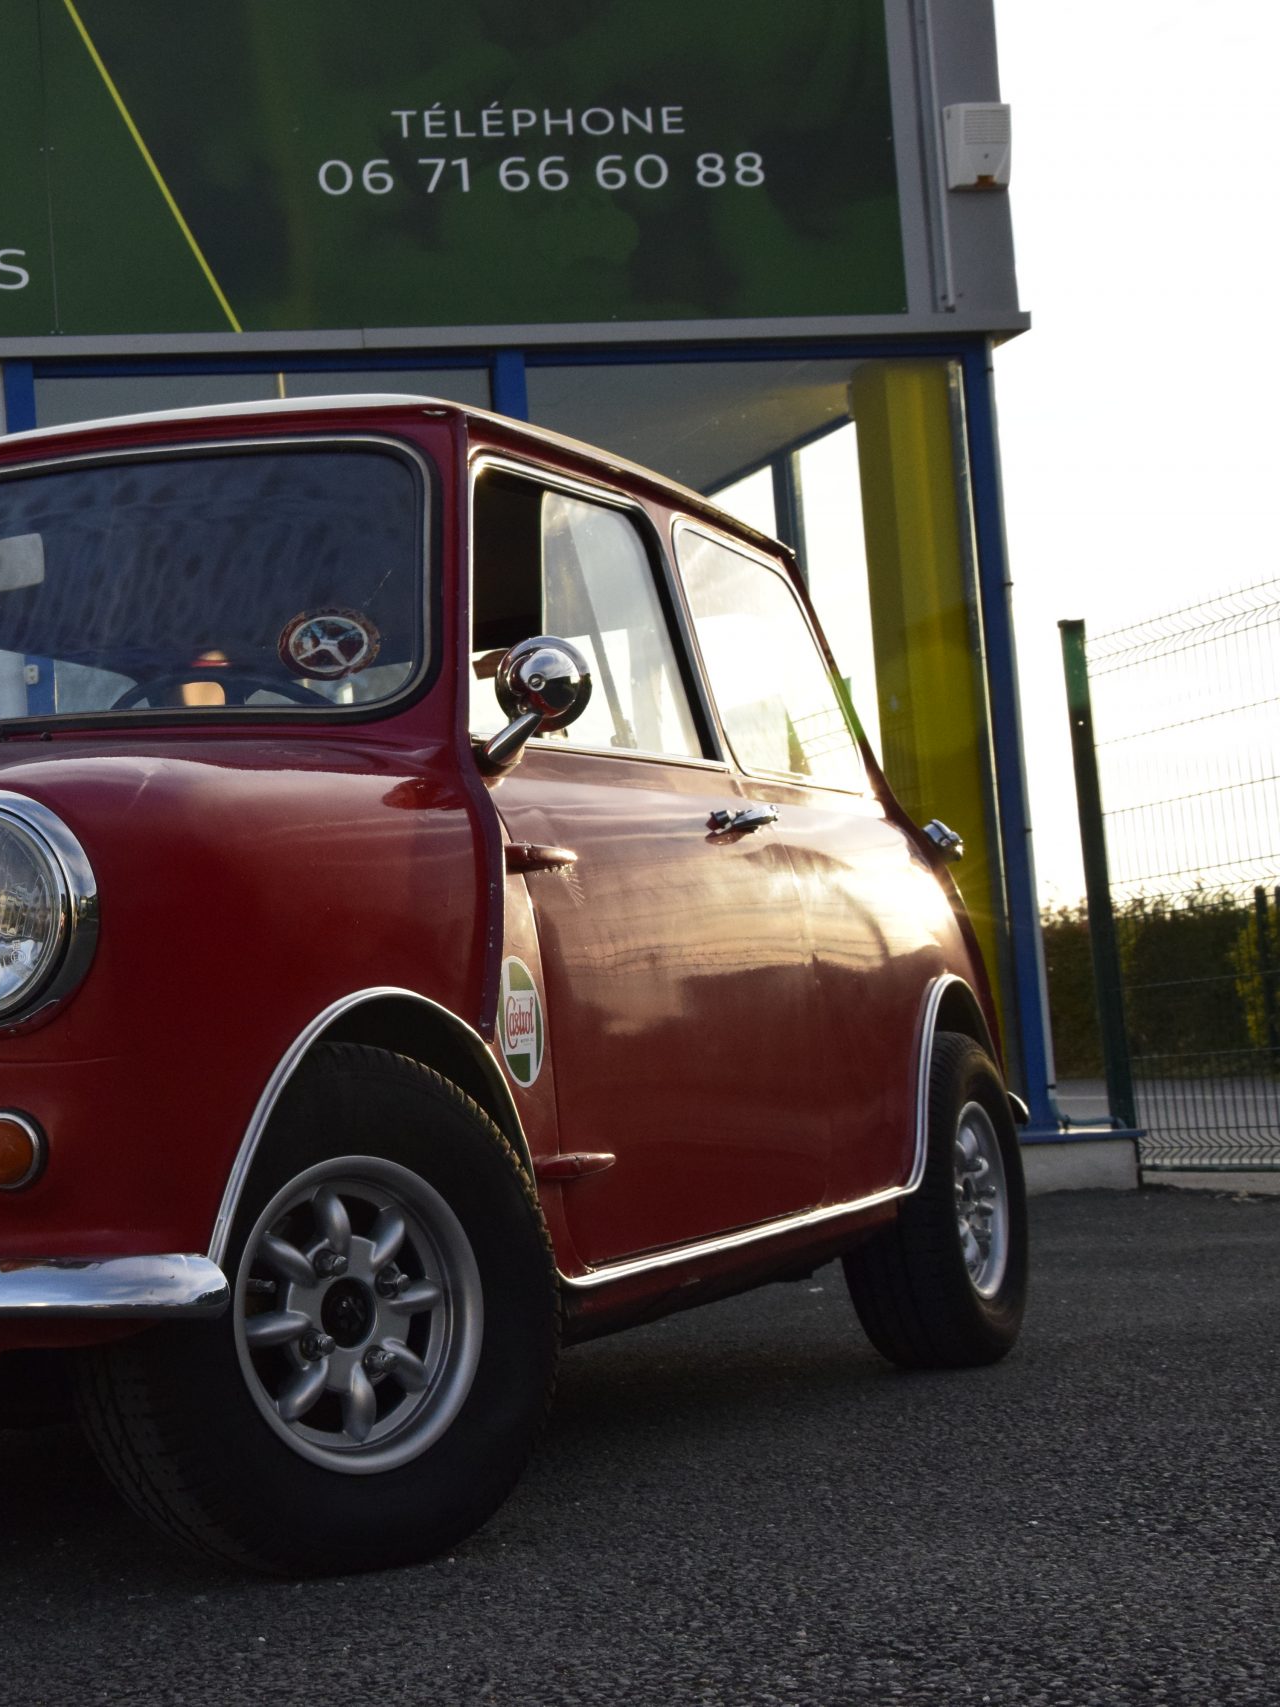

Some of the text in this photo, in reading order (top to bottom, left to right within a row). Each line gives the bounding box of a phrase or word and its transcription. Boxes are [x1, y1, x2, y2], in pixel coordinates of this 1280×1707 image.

[391, 101, 686, 139] TÉLÉPHONE
[318, 152, 766, 196] 06 71 66 60 88
[506, 996, 534, 1049] Castrol
